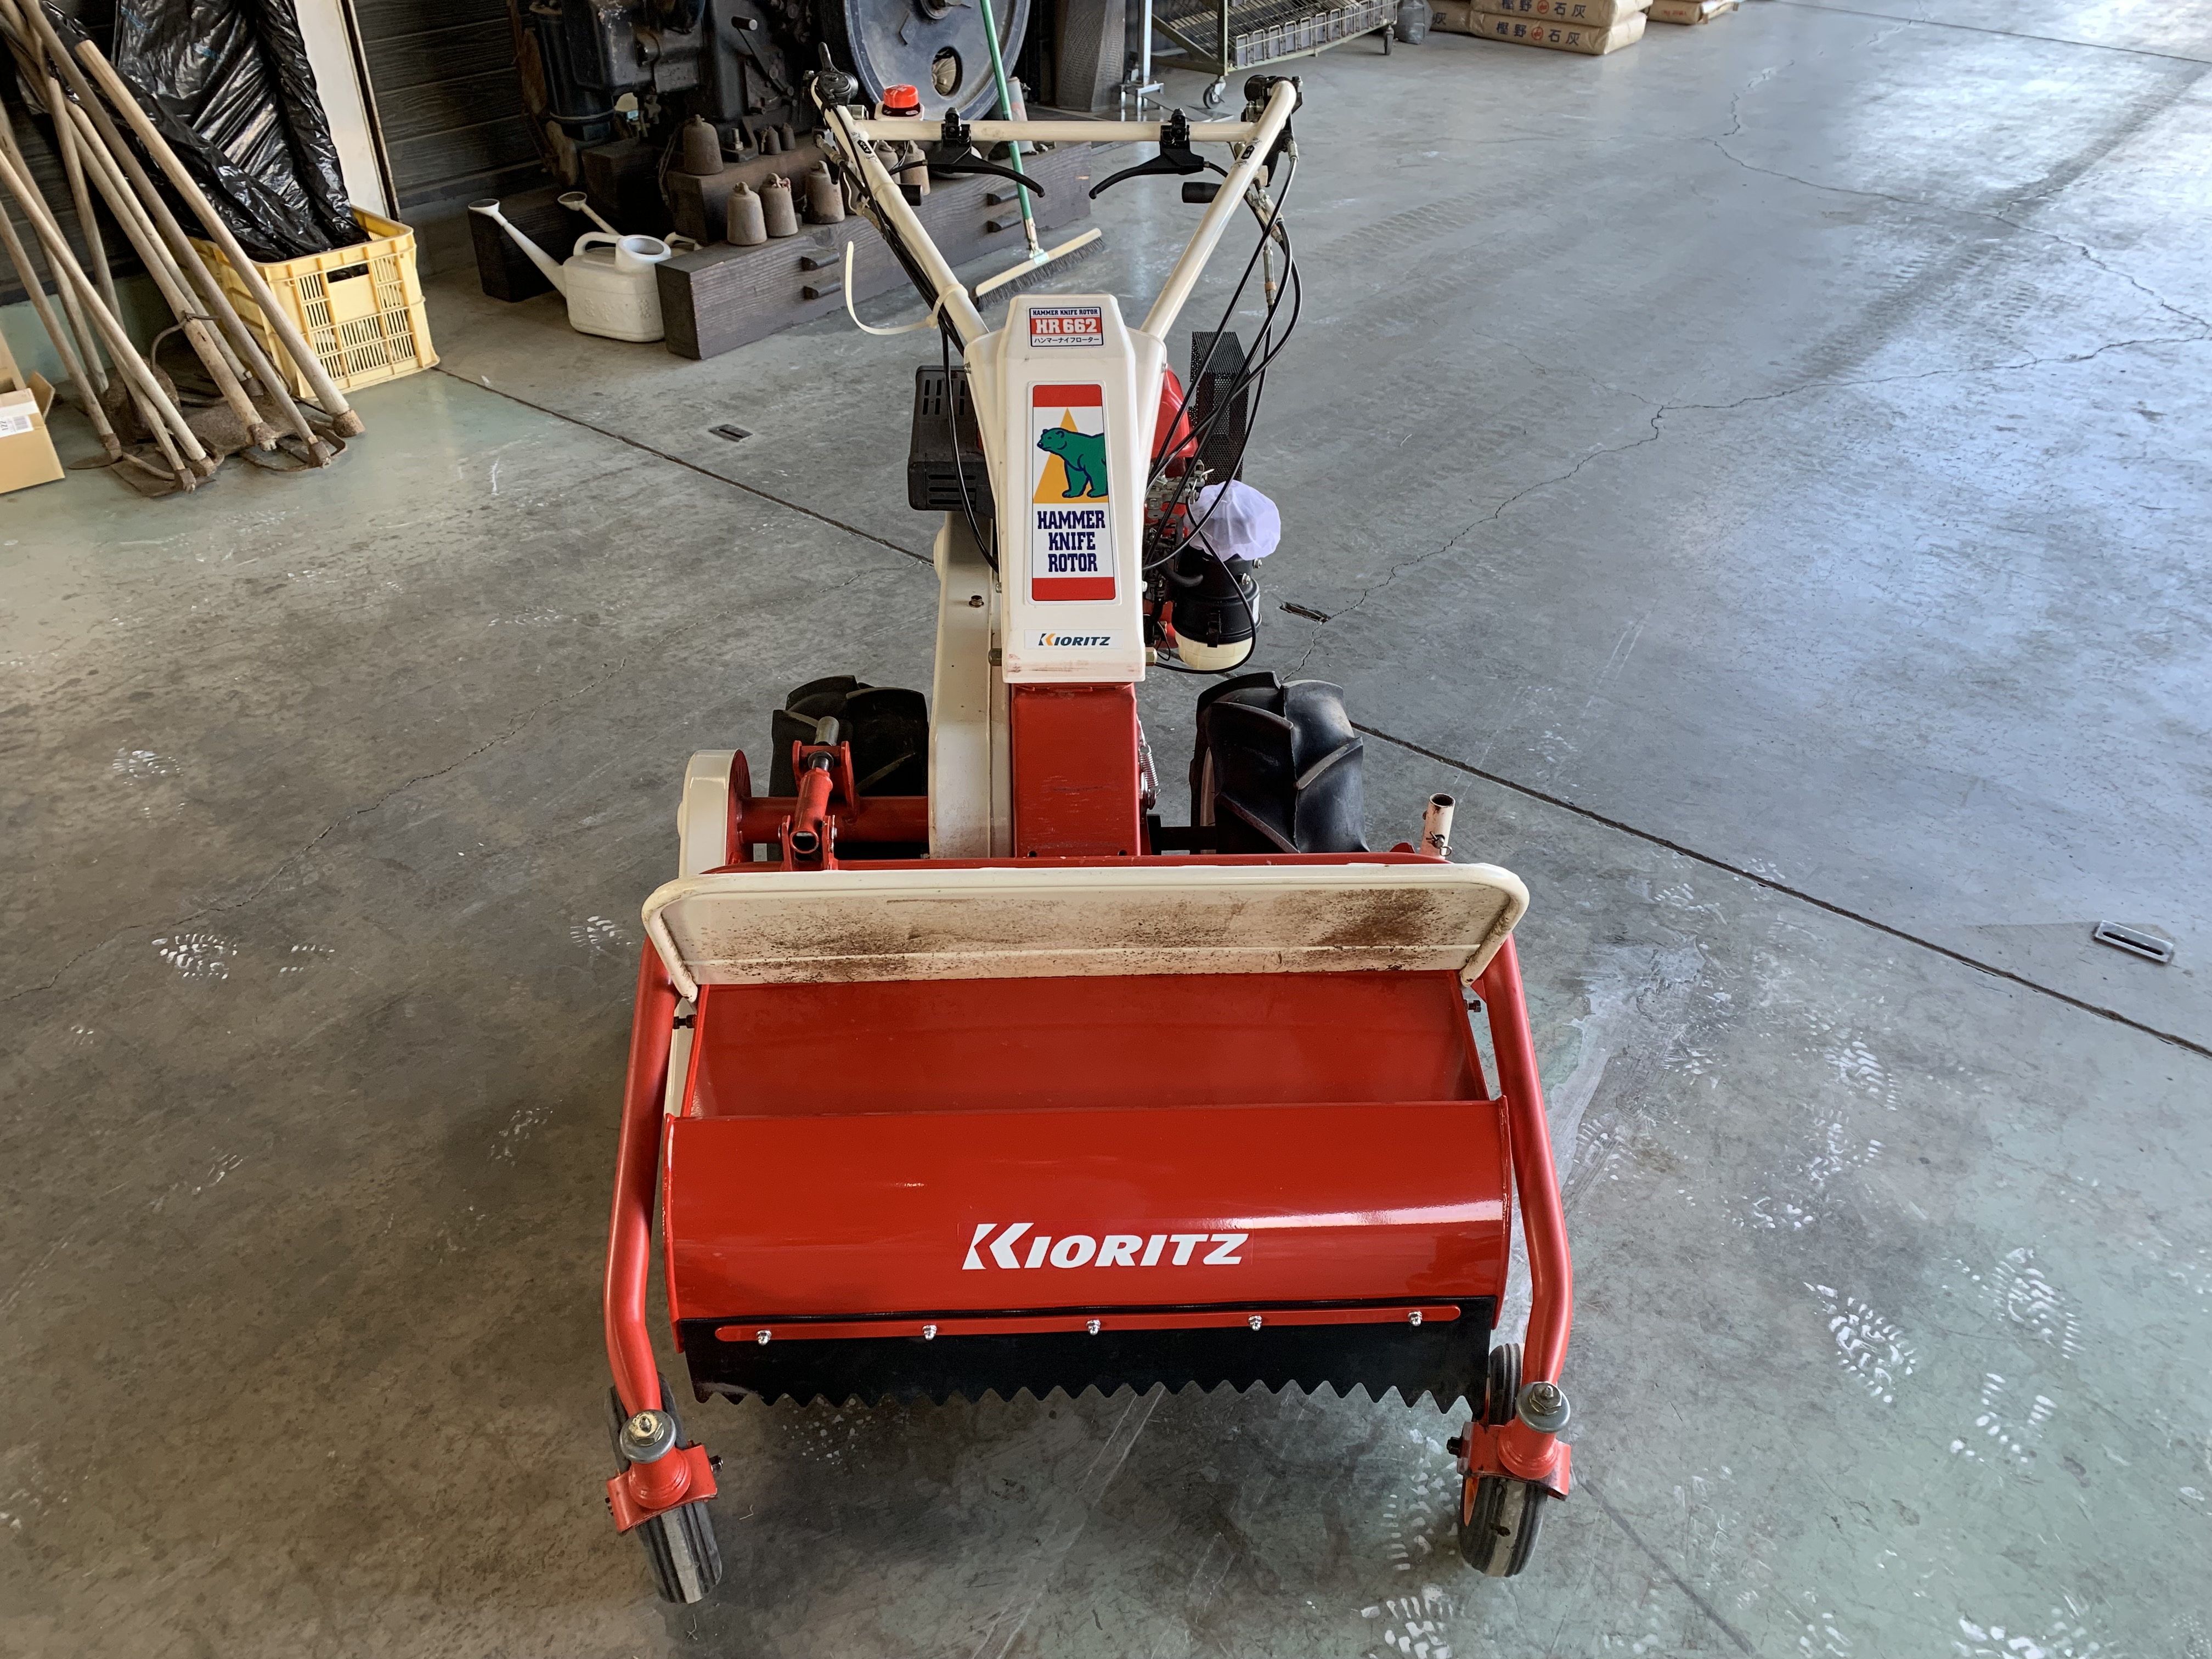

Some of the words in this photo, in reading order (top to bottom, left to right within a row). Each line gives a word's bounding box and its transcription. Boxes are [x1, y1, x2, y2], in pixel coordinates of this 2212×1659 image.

[1554, 2, 1587, 18] 石灰
[1548, 29, 1581, 46] 石灰
[1035, 319, 1060, 334] HR
[1063, 318, 1097, 333] 662
[1037, 510, 1105, 529] HAMMER
[1048, 532, 1096, 551] KNIFE
[1048, 553, 1098, 572] ROTOR
[1039, 633, 1111, 646] KIORITZ
[962, 1222, 1249, 1269] KIORITZ
